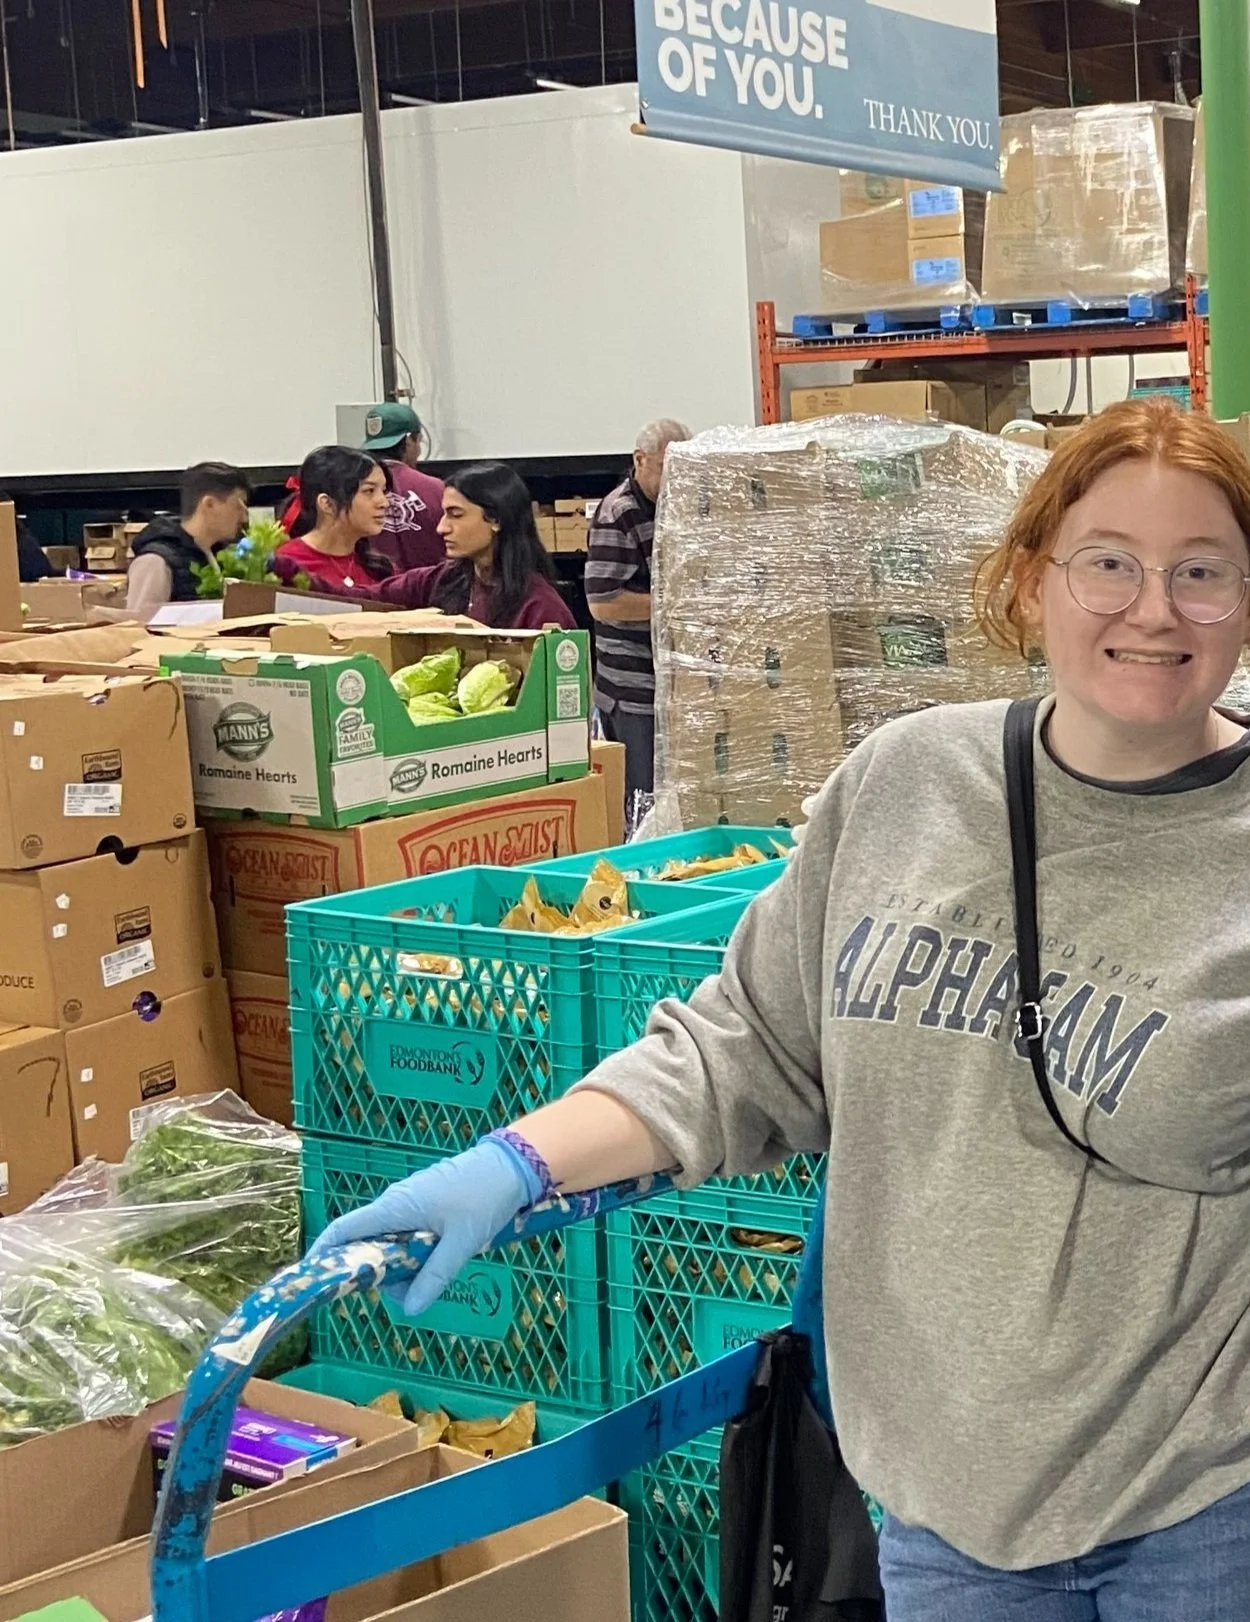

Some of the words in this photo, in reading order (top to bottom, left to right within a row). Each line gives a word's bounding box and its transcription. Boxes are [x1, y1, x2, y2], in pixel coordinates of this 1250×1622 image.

[654, 0, 849, 69] BECAUSE
[657, 37, 717, 97] OF
[724, 49, 823, 119] YOU.
[863, 99, 944, 142] THANK
[947, 116, 993, 150] YOU.
[217, 722, 271, 742] MANN'S
[199, 763, 252, 781] Romaine
[256, 767, 298, 784] Hearts
[391, 766, 427, 787] MANN'S
[431, 754, 495, 780] Romaine
[498, 746, 543, 768] Hearts
[830, 915, 1019, 1042] ALPHA
[1091, 955, 1160, 991] 1904
[390, 1056, 462, 1076] FOODBANK
